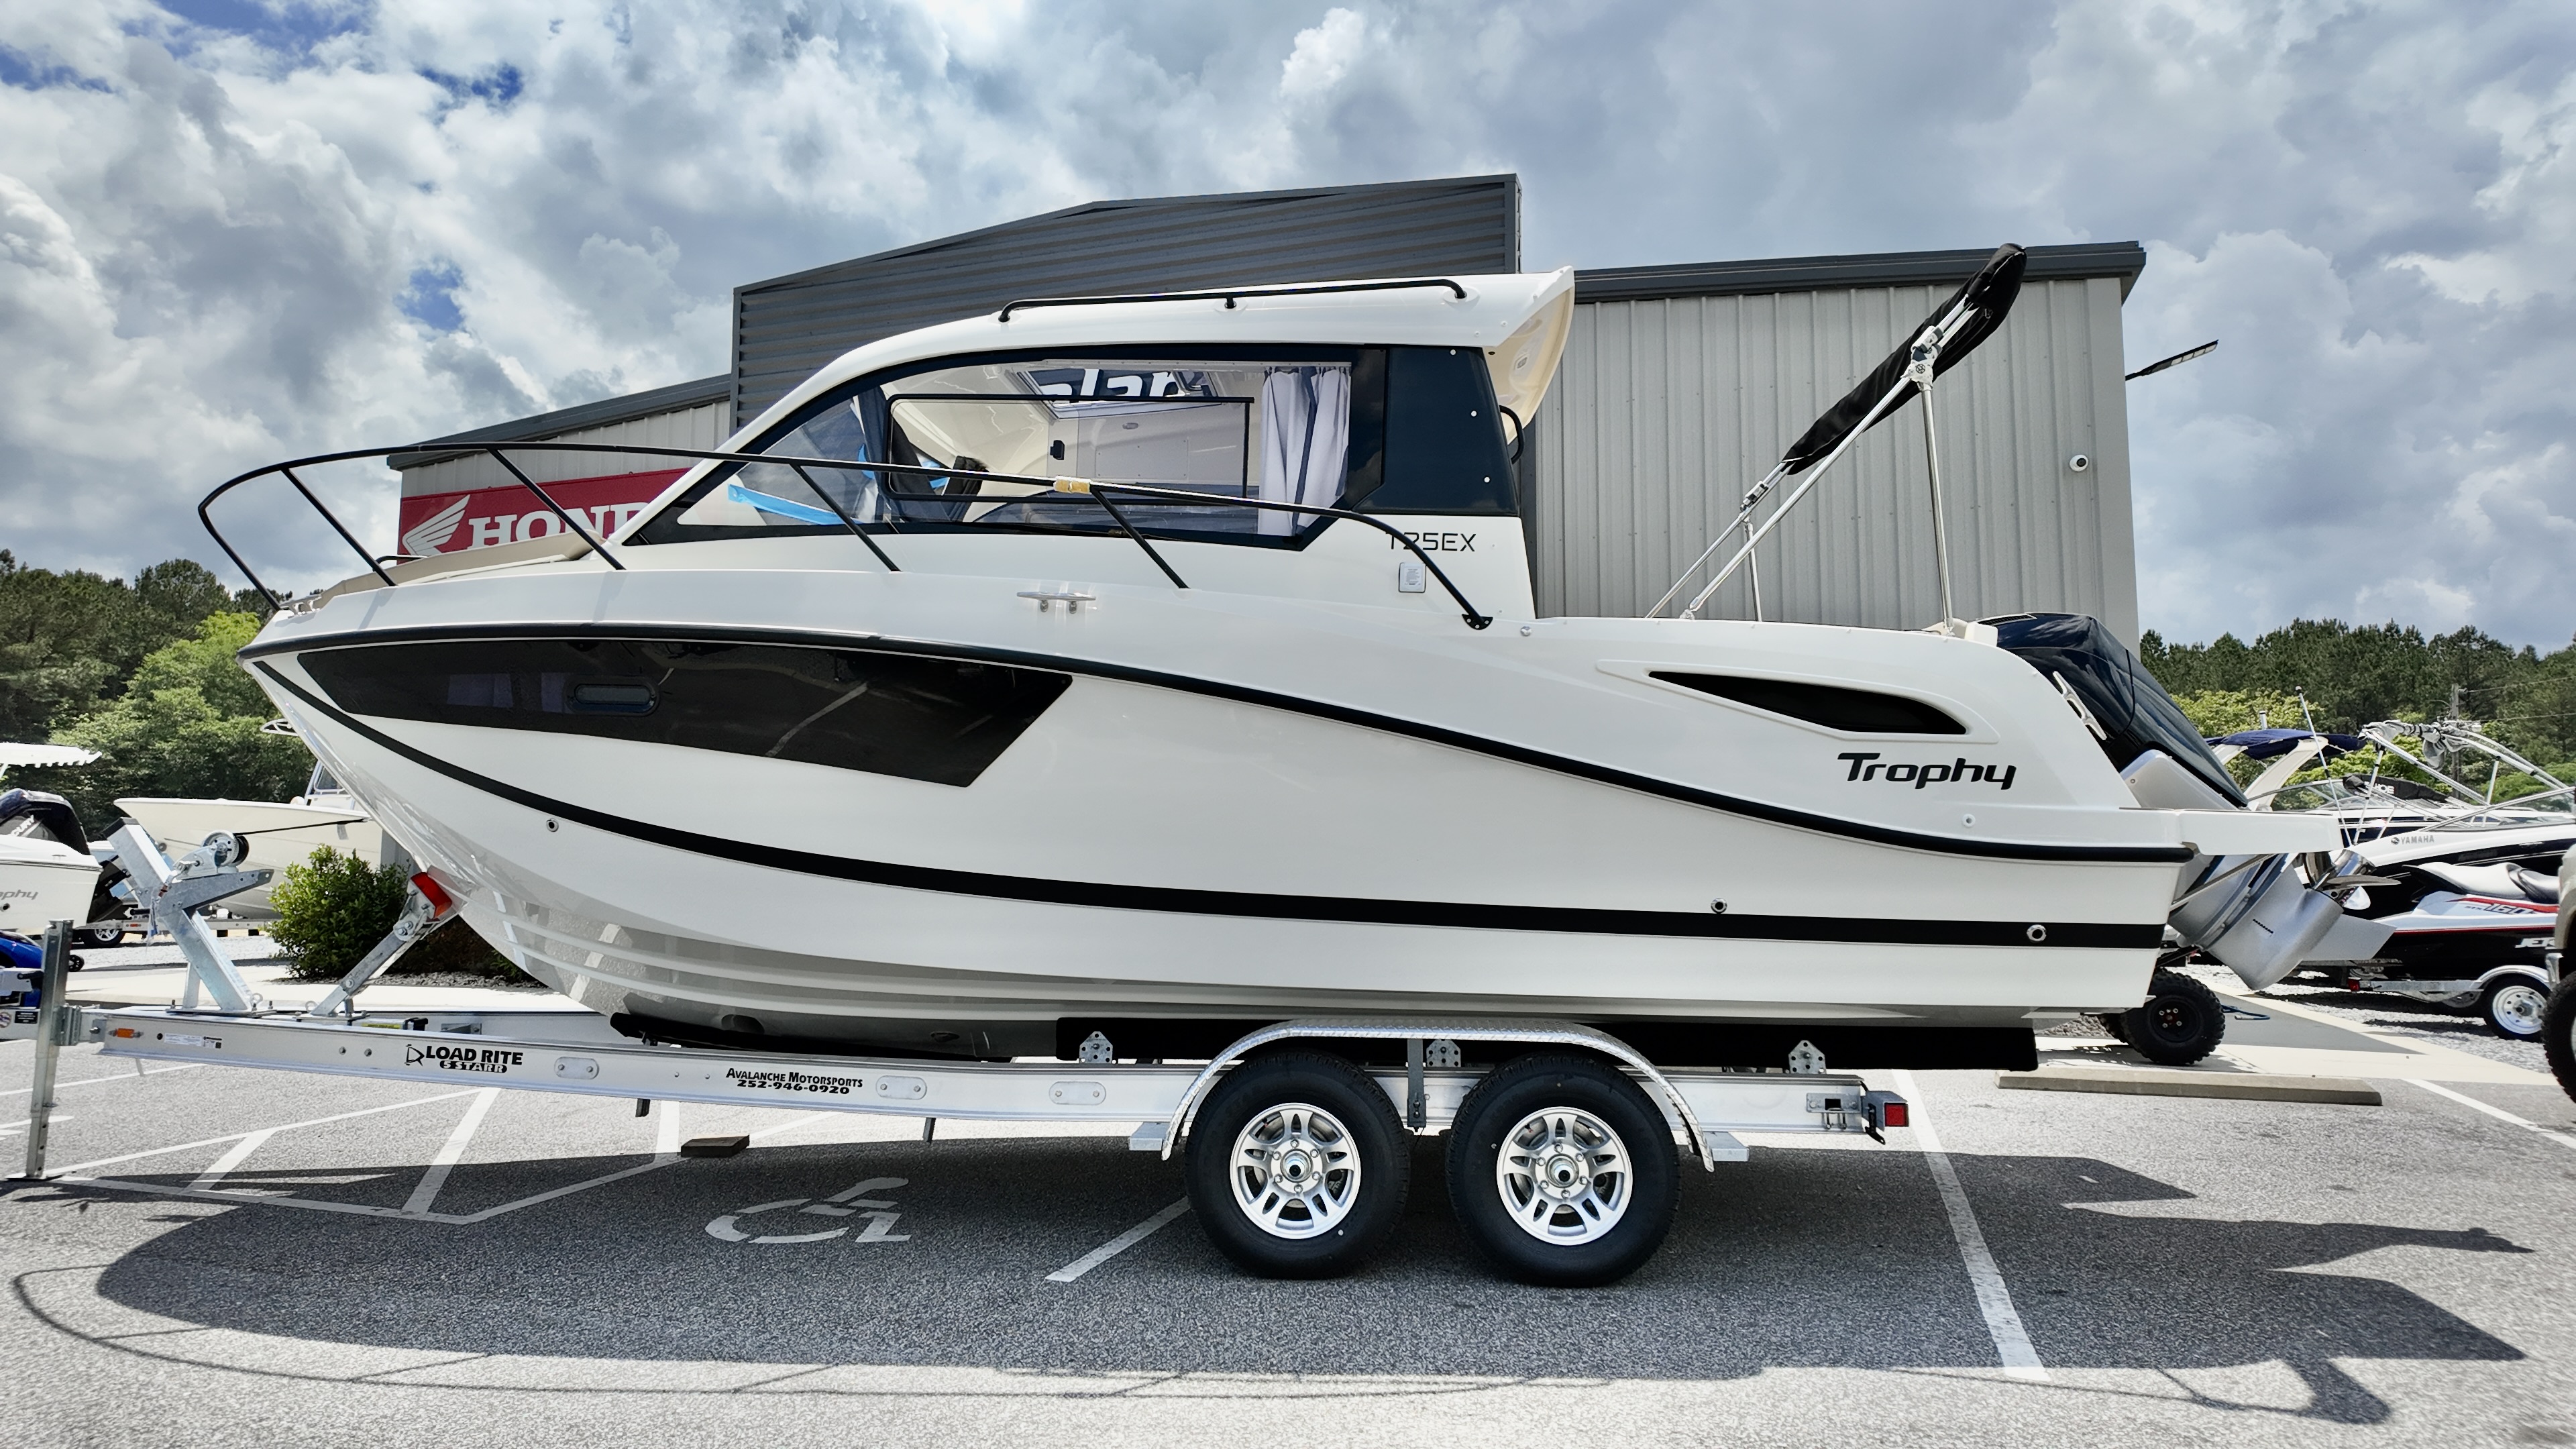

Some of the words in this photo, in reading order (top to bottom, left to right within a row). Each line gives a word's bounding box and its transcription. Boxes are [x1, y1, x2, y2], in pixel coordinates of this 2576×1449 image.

[1837, 752, 2017, 790] Trophy
[2400, 835, 2434, 845] YAMAHA
[425, 1045, 477, 1062] LOAD
[481, 1049, 523, 1065] RITE
[443, 1061, 451, 1069] 5
[454, 1062, 504, 1073] STARR
[725, 1067, 786, 1082] AVALANCHE
[788, 1071, 863, 1087] MOTORSPORTS
[737, 1079, 850, 1095] 252-946-0920
